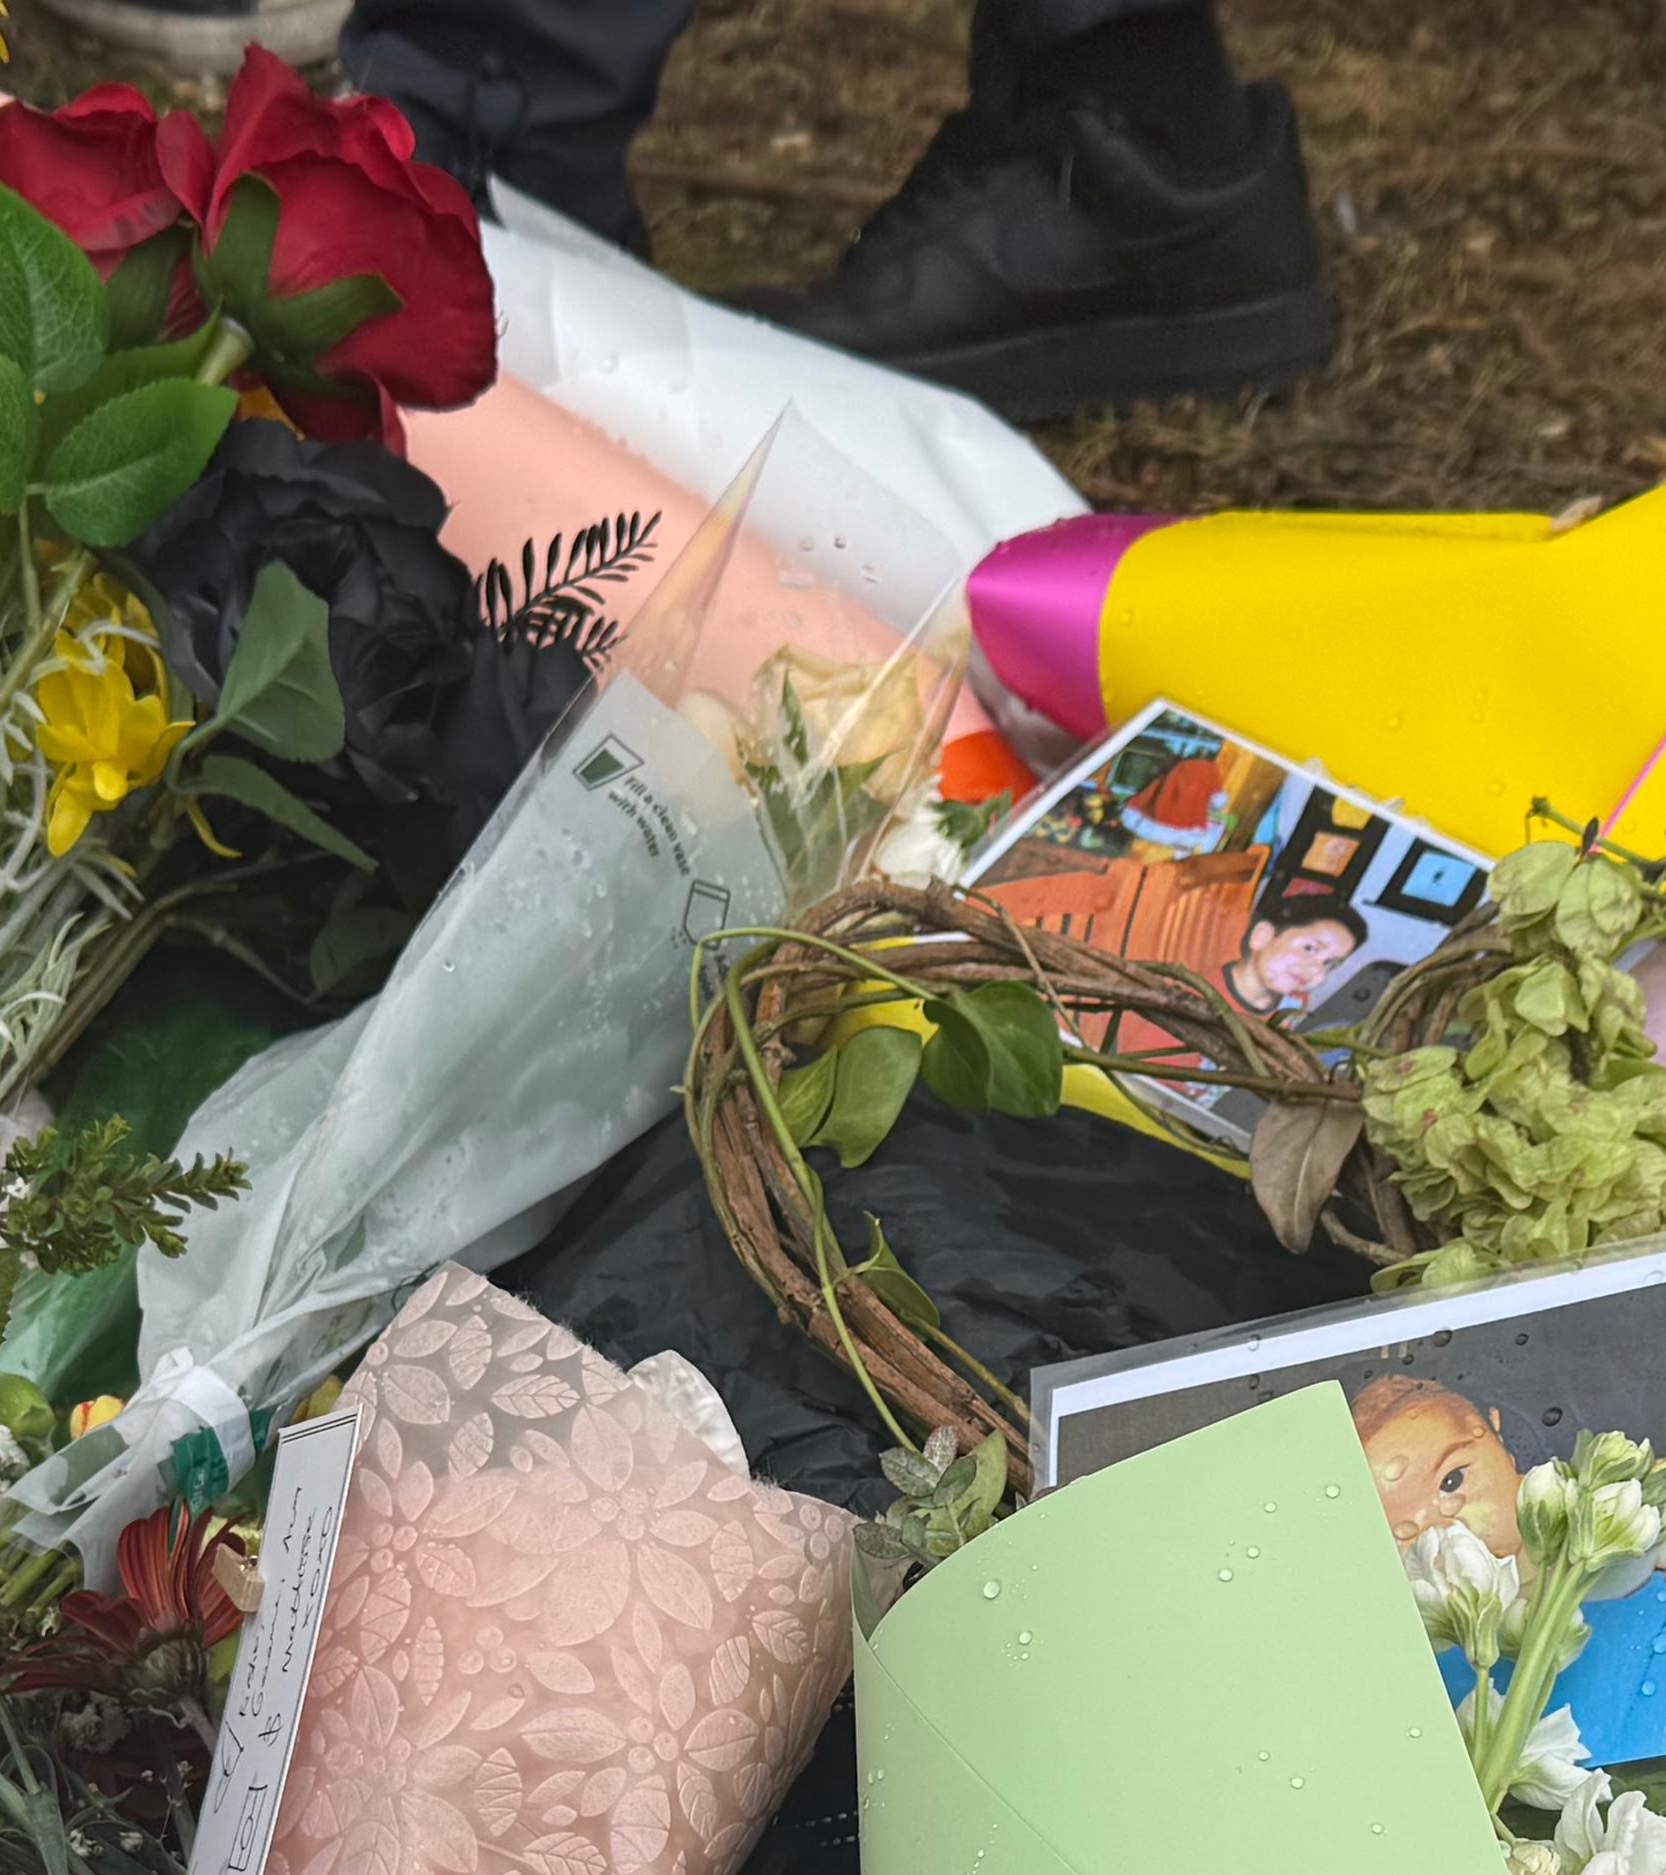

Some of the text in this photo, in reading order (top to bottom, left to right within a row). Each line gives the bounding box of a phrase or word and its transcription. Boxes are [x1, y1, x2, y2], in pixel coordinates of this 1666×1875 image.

[608, 790, 660, 858] with water
[624, 776, 691, 877] Fill a clean vase
